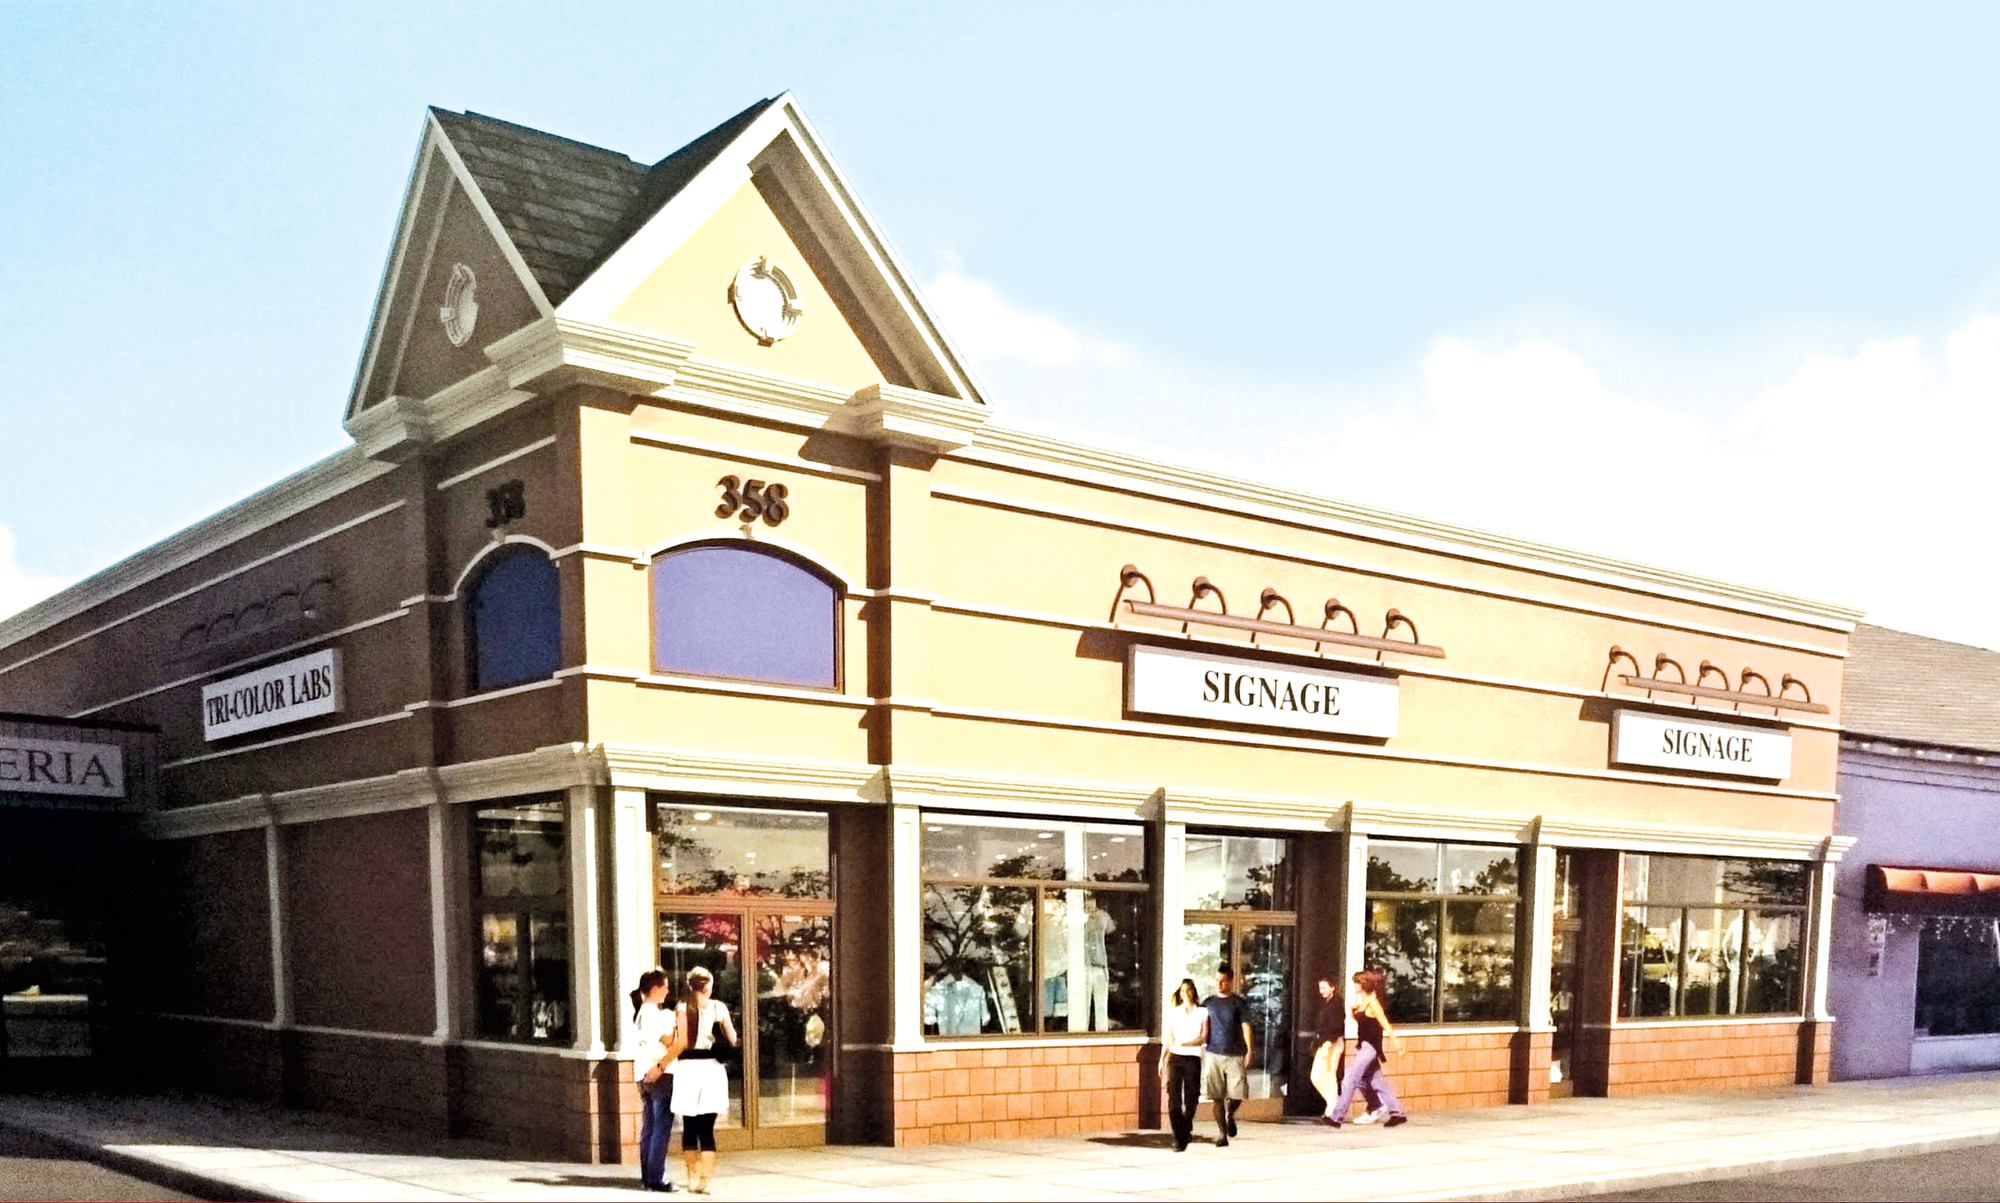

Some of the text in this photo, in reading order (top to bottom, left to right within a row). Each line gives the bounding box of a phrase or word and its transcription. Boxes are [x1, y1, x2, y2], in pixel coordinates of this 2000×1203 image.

[714, 475, 789, 527] 358
[206, 665, 331, 726] TRI-COLOR LABS
[1203, 670, 1340, 716] SIGNAGE
[1662, 728, 1753, 762] SIGNAGE
